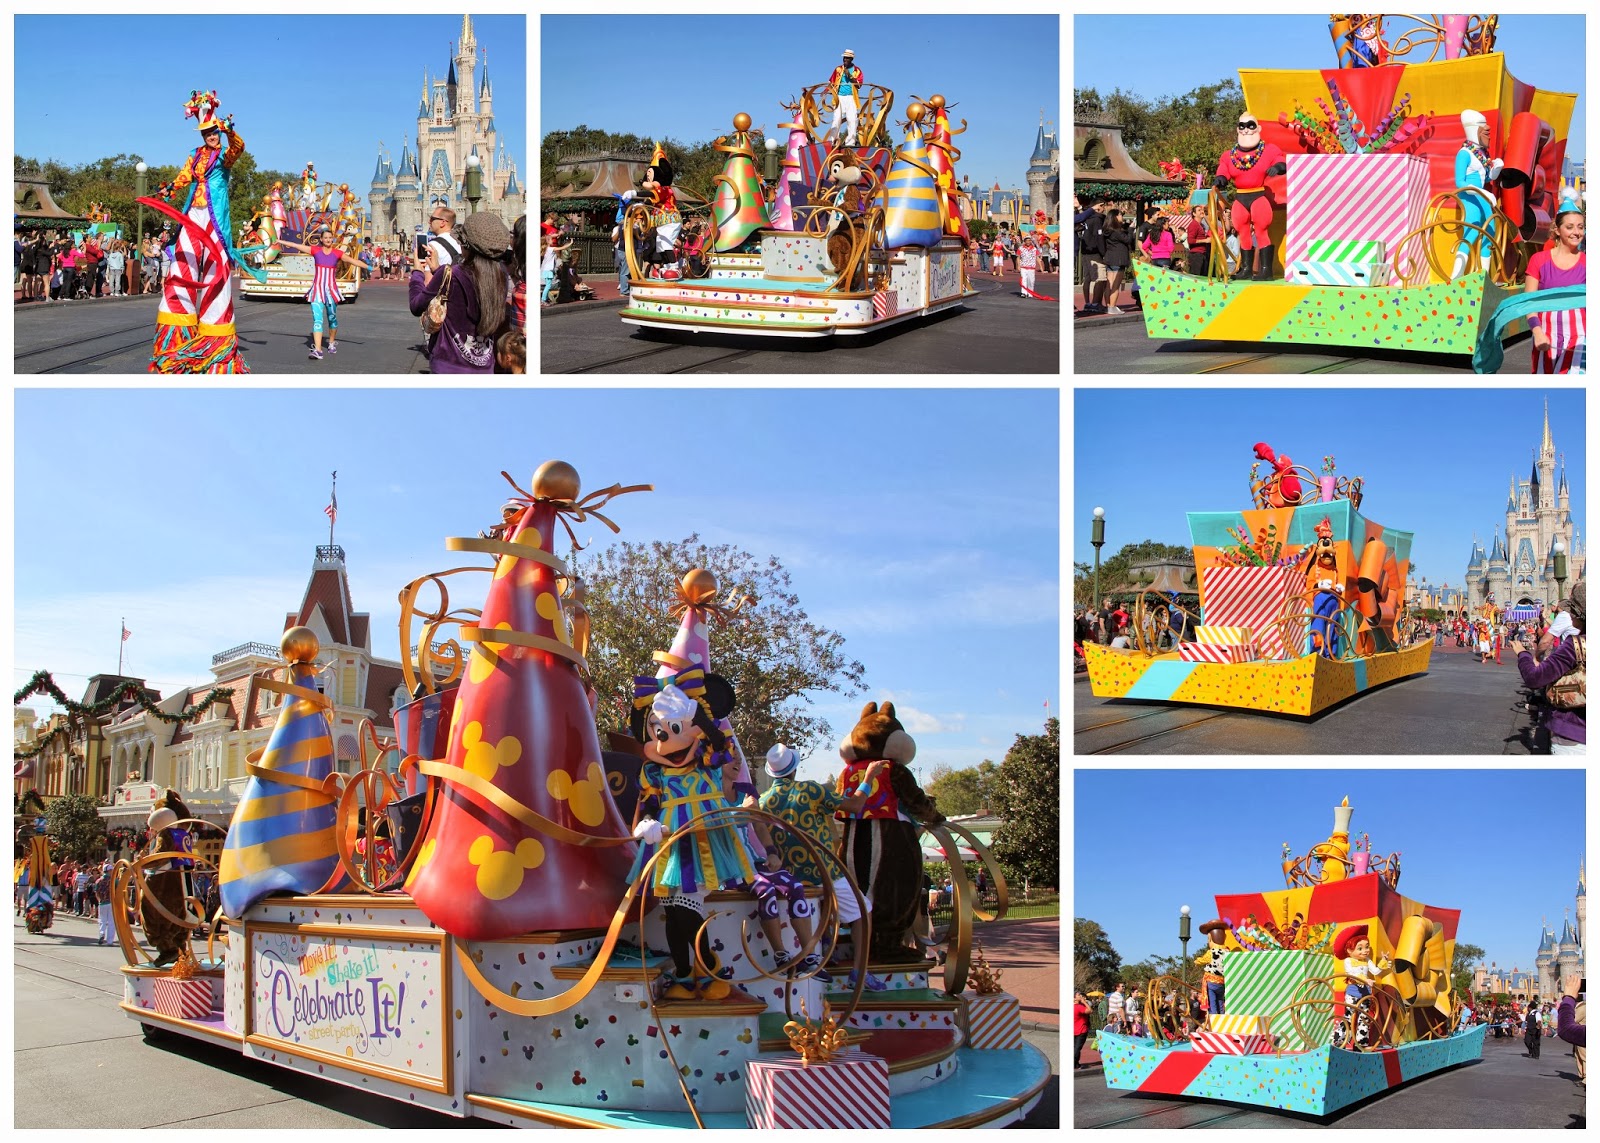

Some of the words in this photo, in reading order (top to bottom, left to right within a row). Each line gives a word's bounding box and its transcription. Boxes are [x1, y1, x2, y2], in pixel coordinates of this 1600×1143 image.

[271, 969, 366, 1038] Celebrate
[366, 977, 406, 1038] It!
[308, 1023, 334, 1040] street
[334, 1023, 360, 1044] party
